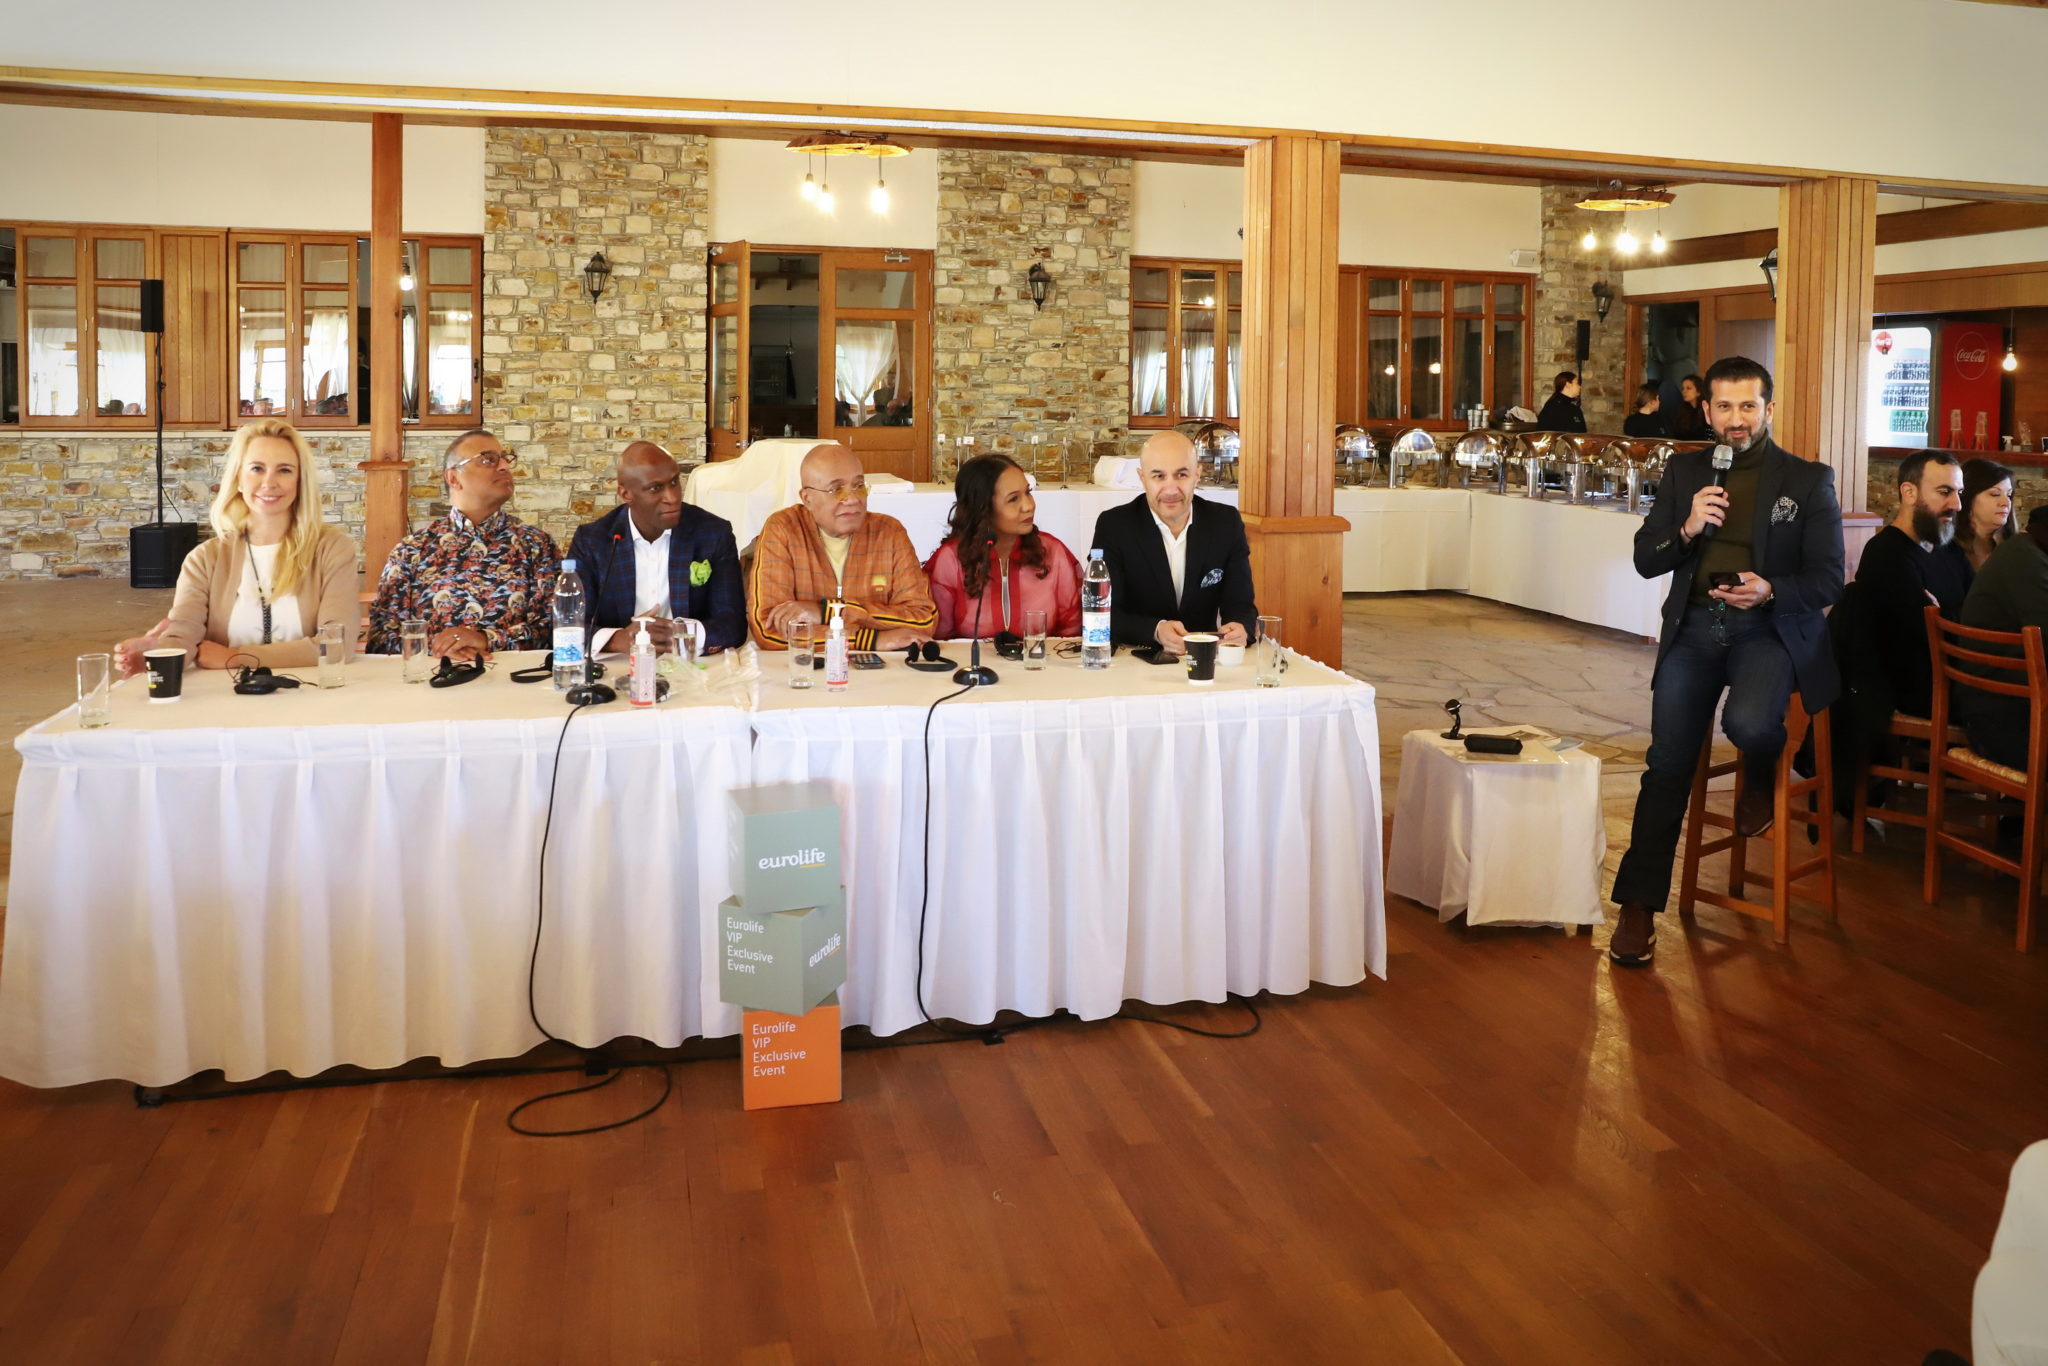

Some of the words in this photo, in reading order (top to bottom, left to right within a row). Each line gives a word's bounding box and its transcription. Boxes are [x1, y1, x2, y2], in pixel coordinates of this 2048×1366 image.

[758, 848, 826, 869] eurolife
[727, 917, 765, 934] Eurolife
[726, 930, 743, 943] VIP
[727, 945, 774, 963] Exclusive
[809, 933, 841, 967] eurolife
[727, 959, 755, 974] Event
[752, 1021, 796, 1035] Eurolife
[752, 1036, 771, 1049] VIP
[753, 1049, 807, 1063] Exclusive
[753, 1065, 785, 1077] Event
